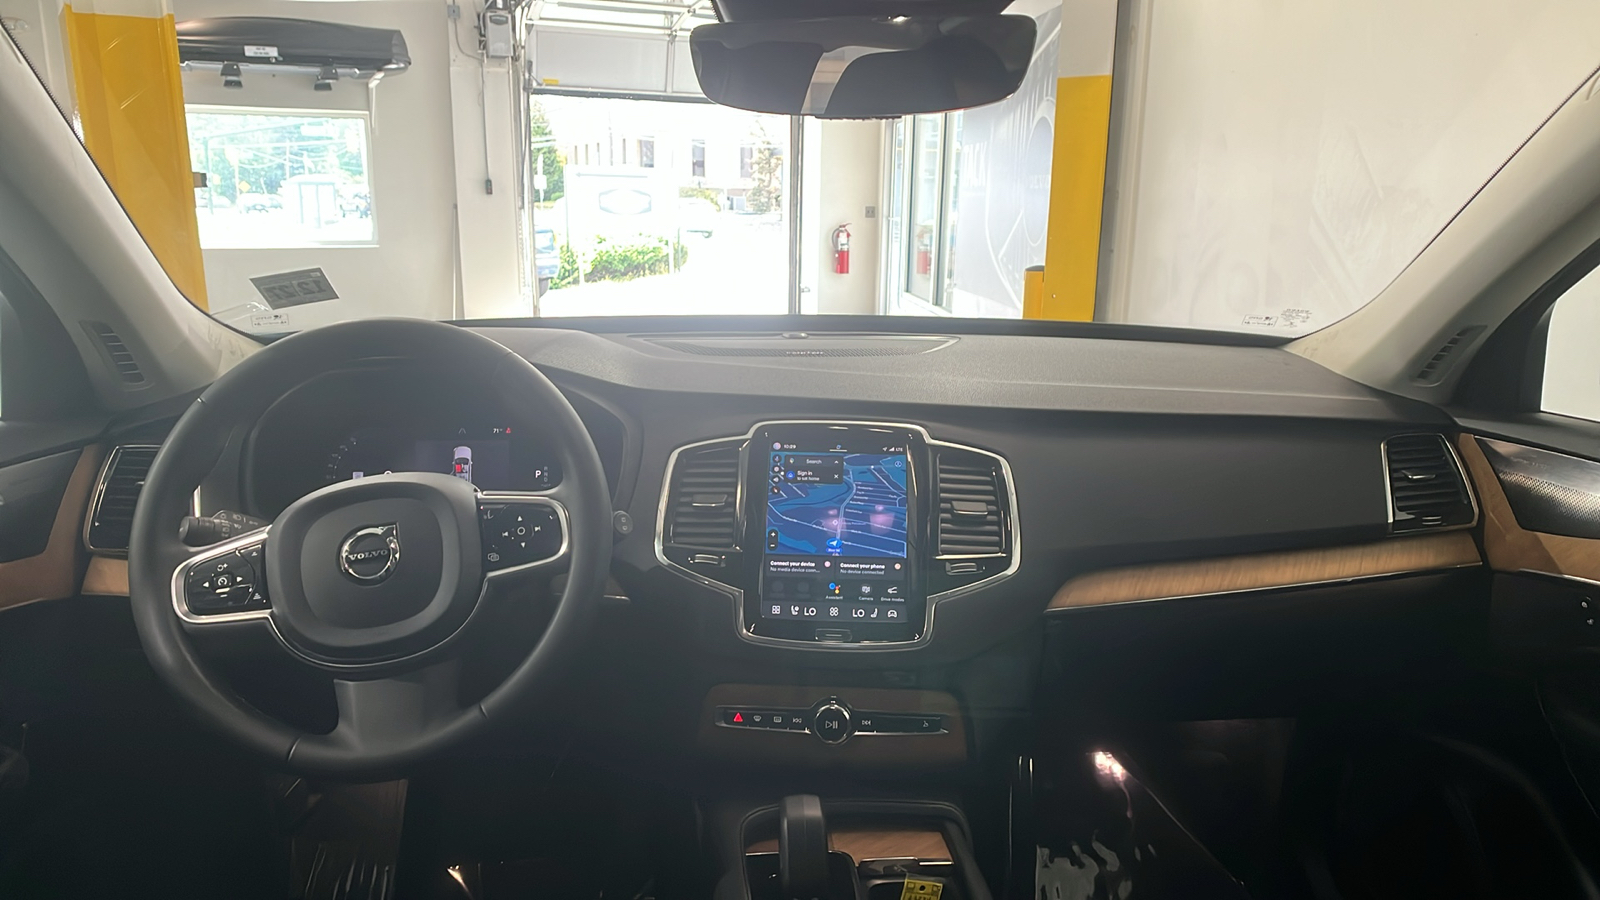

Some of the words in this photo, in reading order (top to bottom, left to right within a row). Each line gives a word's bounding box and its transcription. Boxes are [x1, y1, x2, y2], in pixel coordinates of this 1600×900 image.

[536, 470, 542, 478] P
[348, 549, 388, 561] VOLVO
[804, 607, 817, 616] LO
[852, 608, 865, 618] LO
